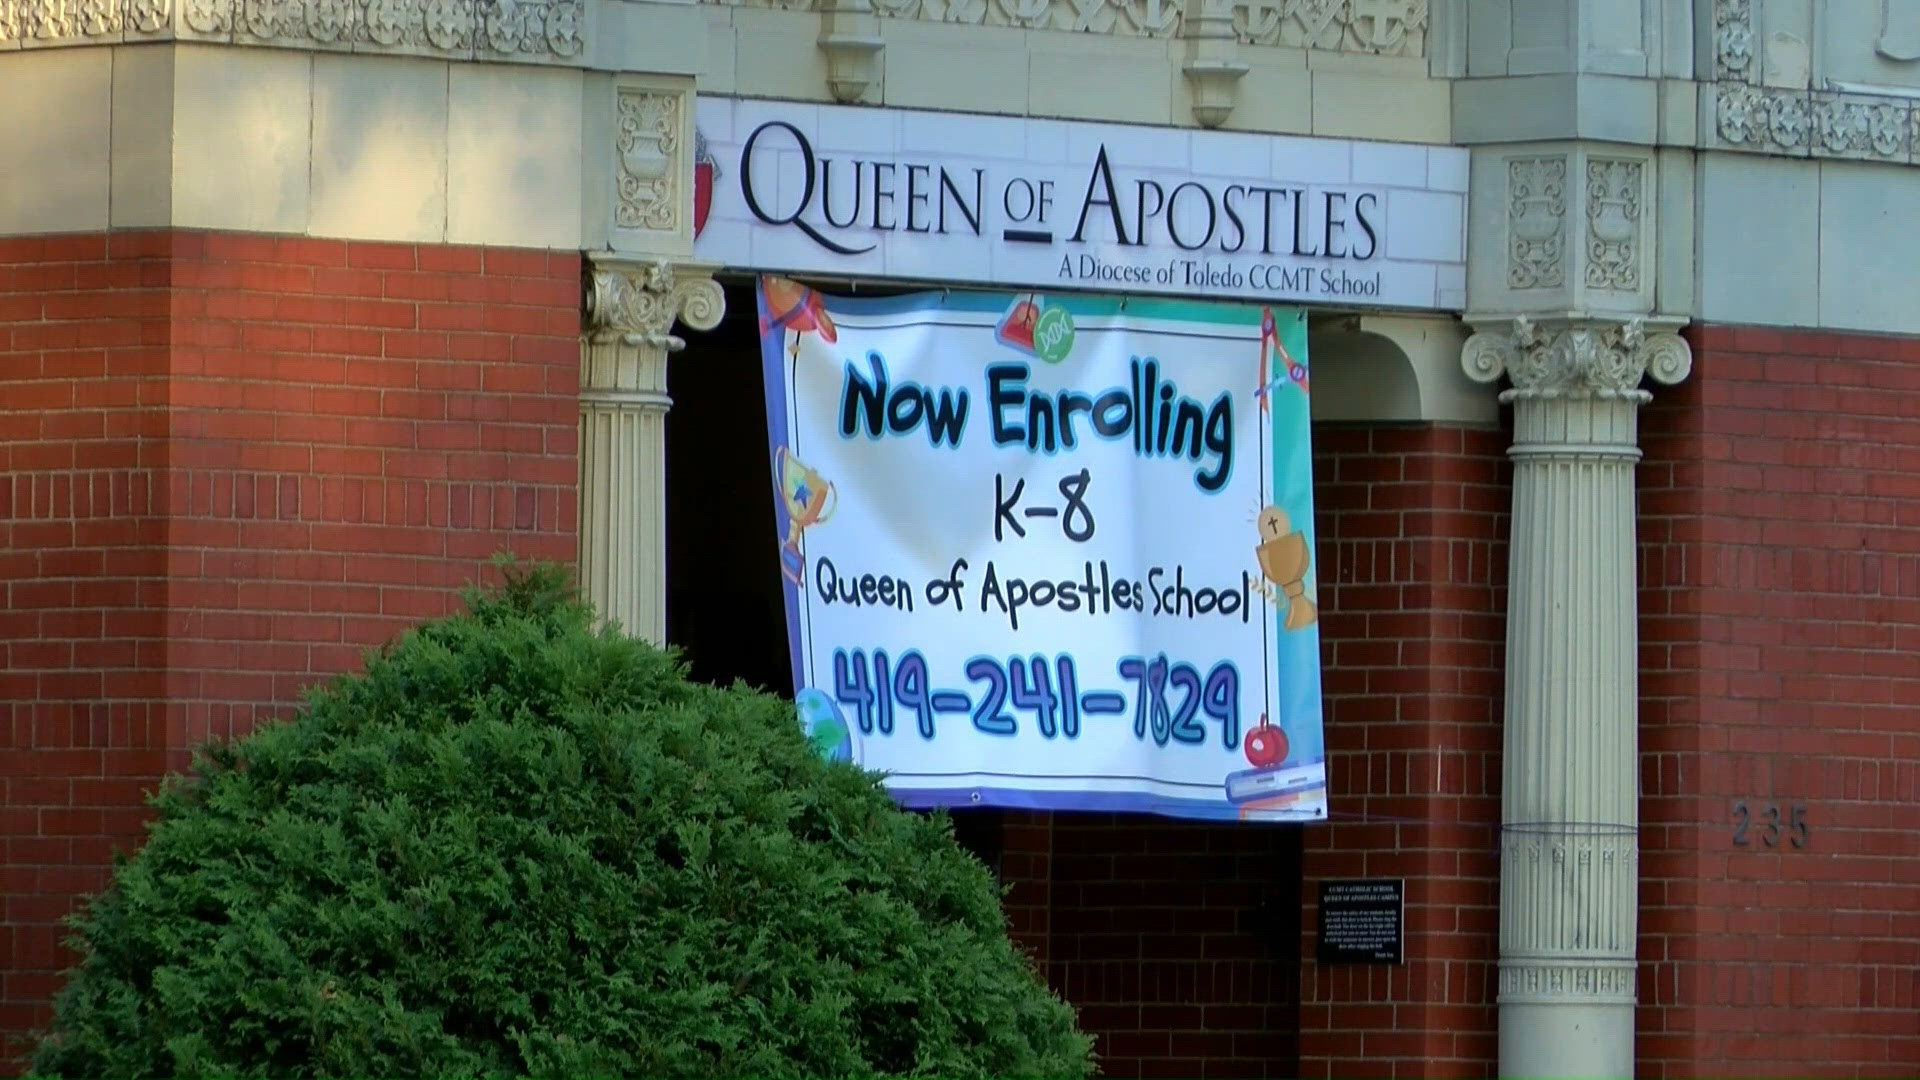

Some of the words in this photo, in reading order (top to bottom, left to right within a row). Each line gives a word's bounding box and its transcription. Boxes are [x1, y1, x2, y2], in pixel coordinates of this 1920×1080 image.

[740, 121, 986, 254] QUEEN
[1003, 177, 1055, 223] OF
[1065, 143, 1378, 261] APOSTLES
[1058, 253, 1074, 279] A
[1079, 255, 1151, 284] Diocese
[1156, 258, 1176, 285] of
[1180, 259, 1244, 289] Toledo
[1248, 263, 1316, 293] CCMT
[1319, 267, 1380, 297] School
[839, 351, 970, 449] Now
[985, 356, 1236, 494] Enrolling
[993, 467, 1096, 543] K-8
[815, 556, 913, 613] Queen
[923, 557, 969, 612] of
[980, 559, 1144, 631] Apostles
[1146, 564, 1250, 624] School
[832, 645, 1242, 751] 419-241-7829
[1732, 799, 1809, 849] 235
